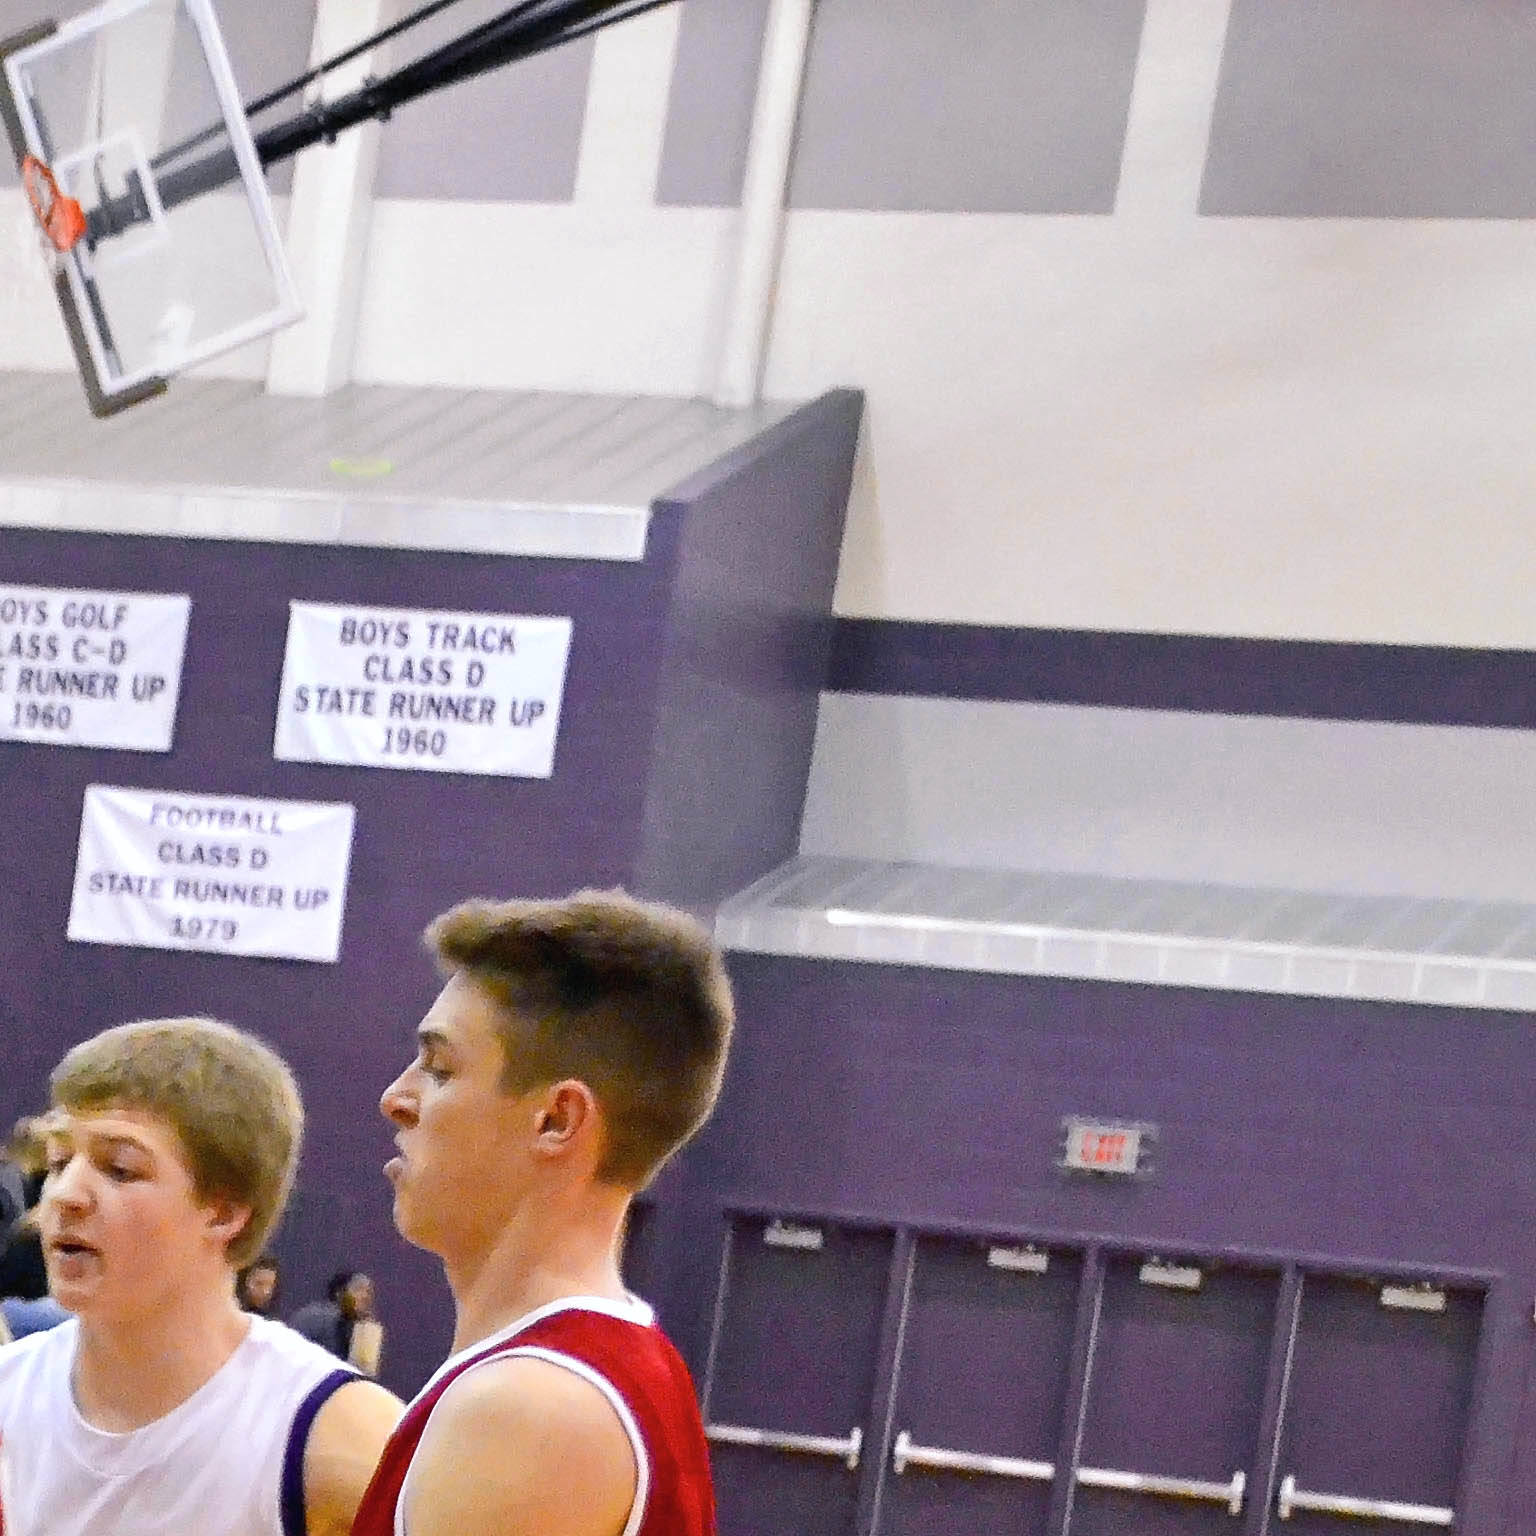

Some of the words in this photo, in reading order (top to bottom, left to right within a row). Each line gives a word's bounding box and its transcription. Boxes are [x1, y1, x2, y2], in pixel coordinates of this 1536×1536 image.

[62, 602, 128, 630] GOLF
[73, 636, 127, 665] C-D
[340, 617, 410, 647] BOYS
[427, 621, 516, 653] TRACK
[17, 667, 119, 699] RUNNER
[131, 673, 166, 702] UP
[364, 655, 453, 686] CLASS
[466, 660, 485, 689] D
[14, 701, 72, 730] 1960
[294, 684, 376, 716] STATE
[389, 691, 496, 725] RUNNER
[511, 698, 546, 728] UP
[382, 727, 447, 756] 1960
[149, 802, 283, 836] FOOTBALL
[158, 840, 240, 868] CLASS
[249, 848, 268, 870] D
[88, 872, 165, 898] STATE
[175, 878, 284, 909] RUNNER
[294, 886, 329, 911] UP
[171, 915, 240, 941] 1979
